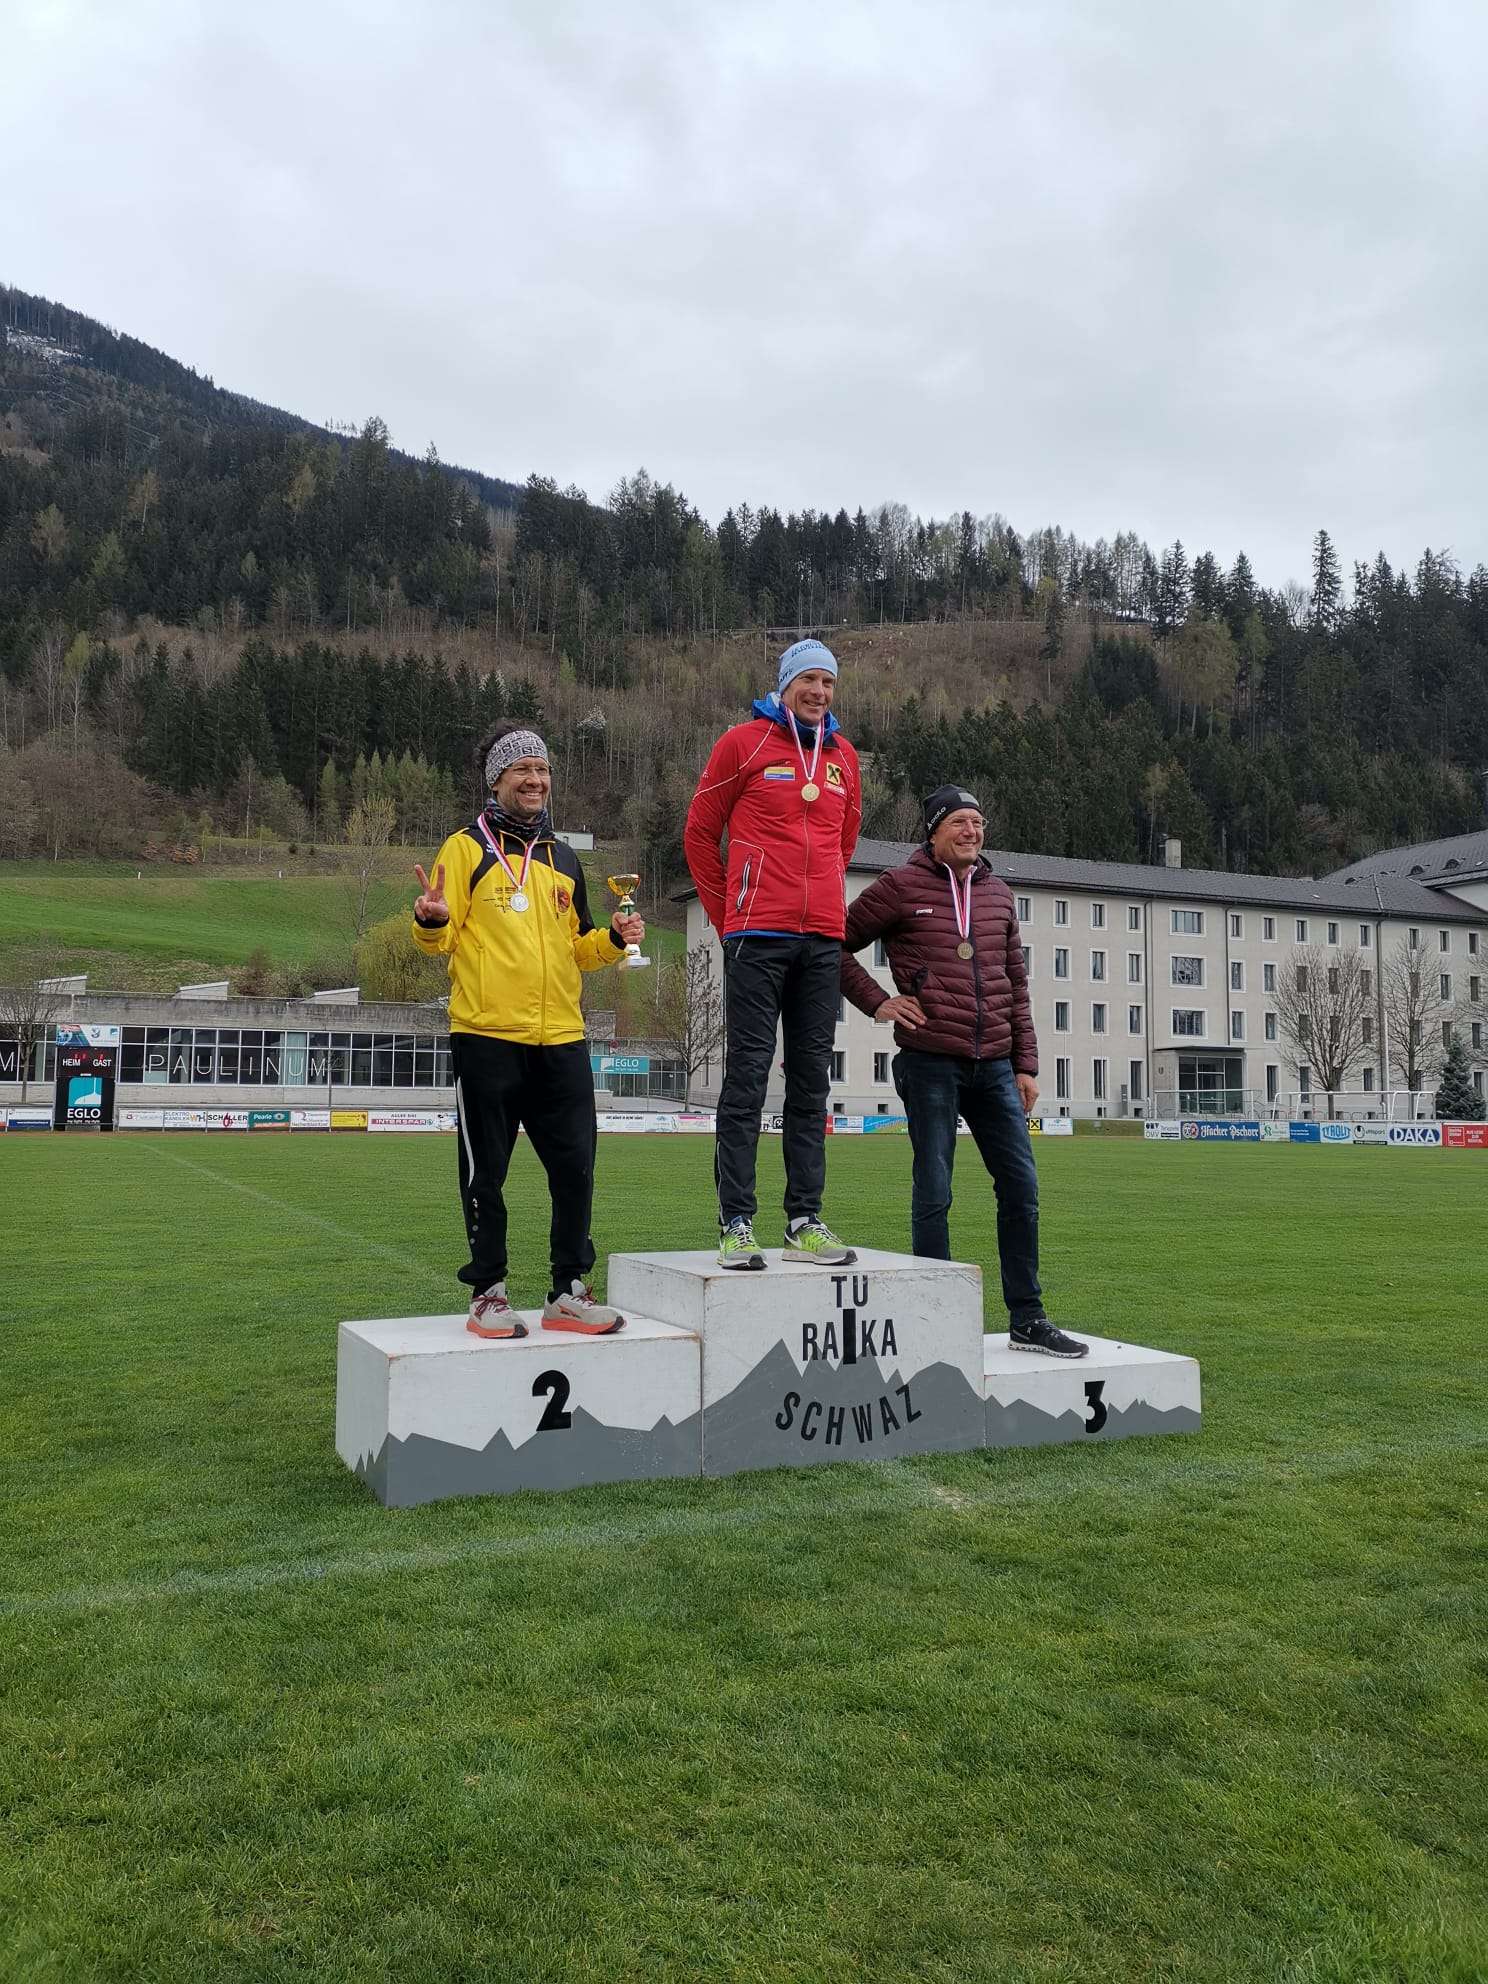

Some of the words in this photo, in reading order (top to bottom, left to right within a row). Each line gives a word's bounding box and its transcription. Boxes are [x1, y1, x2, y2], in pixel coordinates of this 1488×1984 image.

[62, 1058, 81, 1067] HEIM
[92, 1058, 112, 1067] GAST
[148, 1054, 327, 1077] PAULINUM
[615, 1058, 639, 1068] EGLO
[67, 1108, 101, 1119] EGLO
[1393, 1127, 1437, 1143] DAKA
[830, 1275, 869, 1308] TU
[531, 1369, 572, 1431] 2
[1083, 1379, 1108, 1434] 3
[776, 1383, 923, 1446] SCHWAZ
